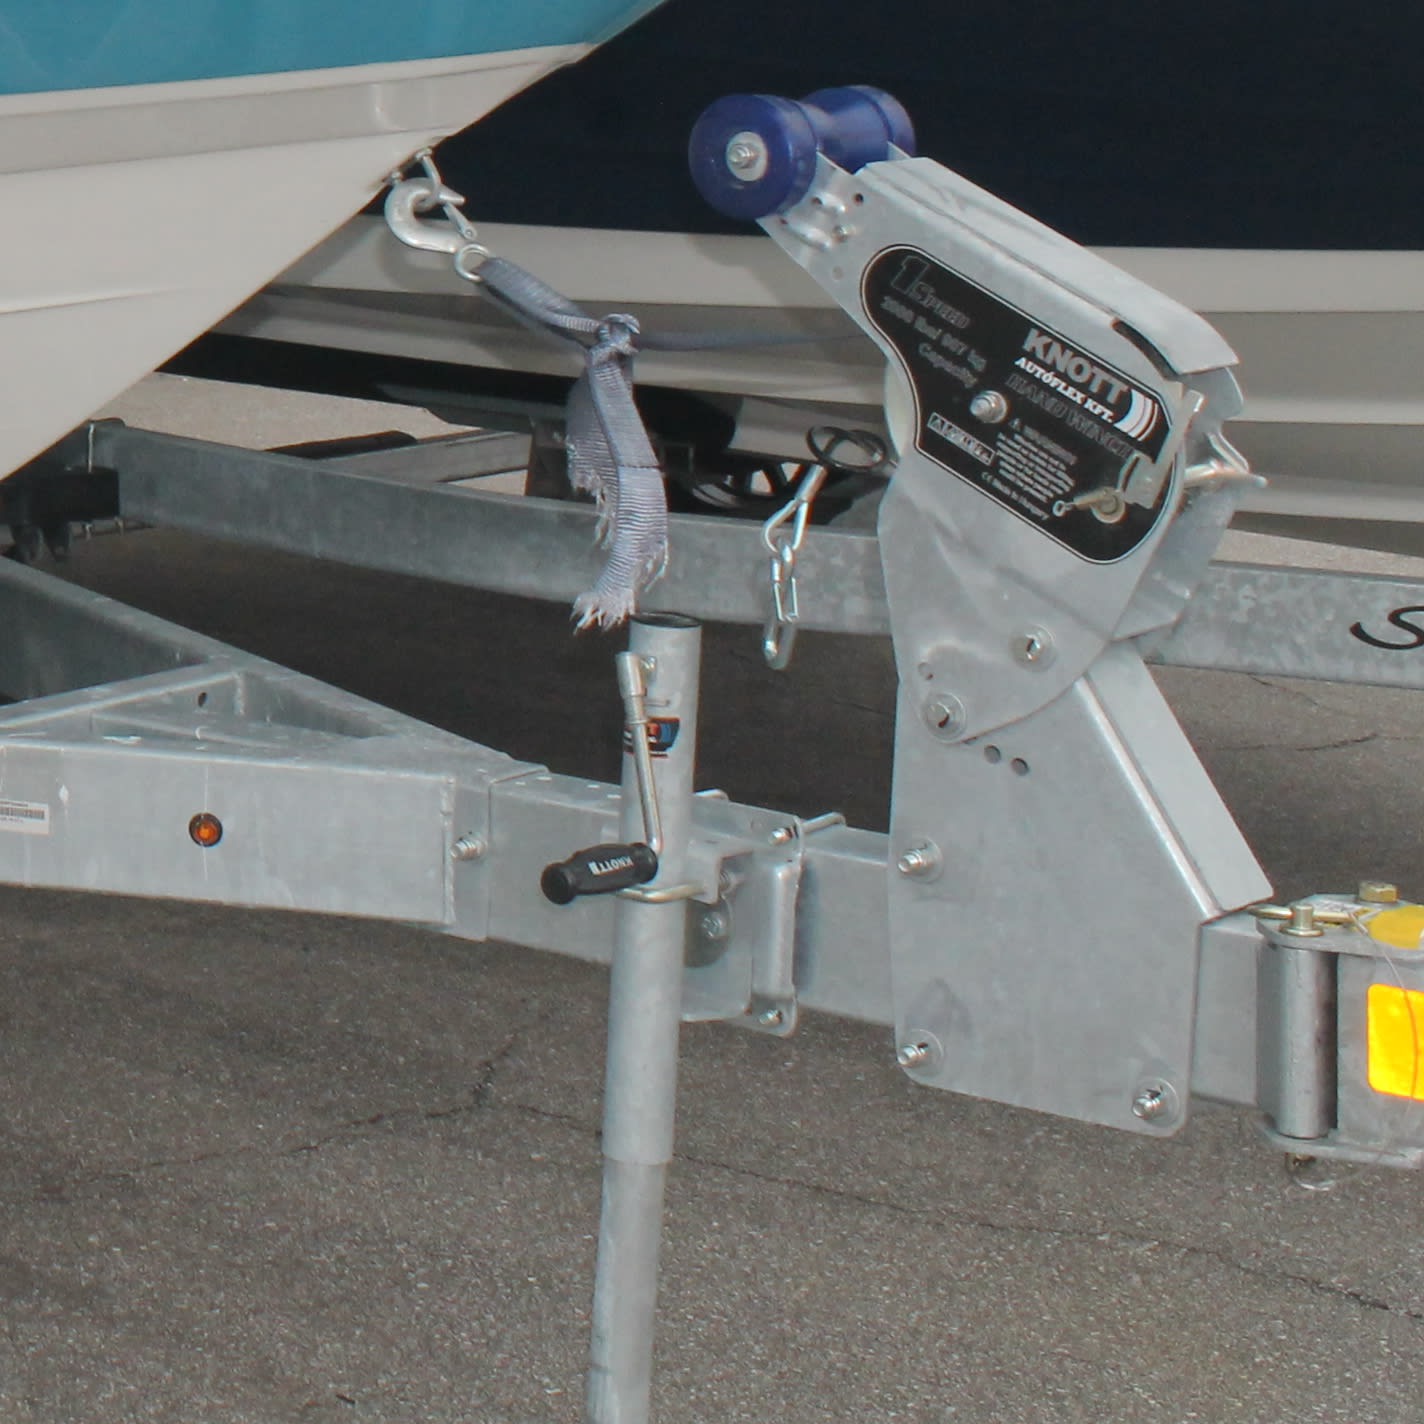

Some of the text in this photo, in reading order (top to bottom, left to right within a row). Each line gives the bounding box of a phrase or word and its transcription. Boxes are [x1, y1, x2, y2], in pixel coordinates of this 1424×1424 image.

[1014, 356, 1085, 404] AUTÓFLEX
[1021, 330, 1130, 402] KNOTT
[599, 856, 634, 872] KNOTT
